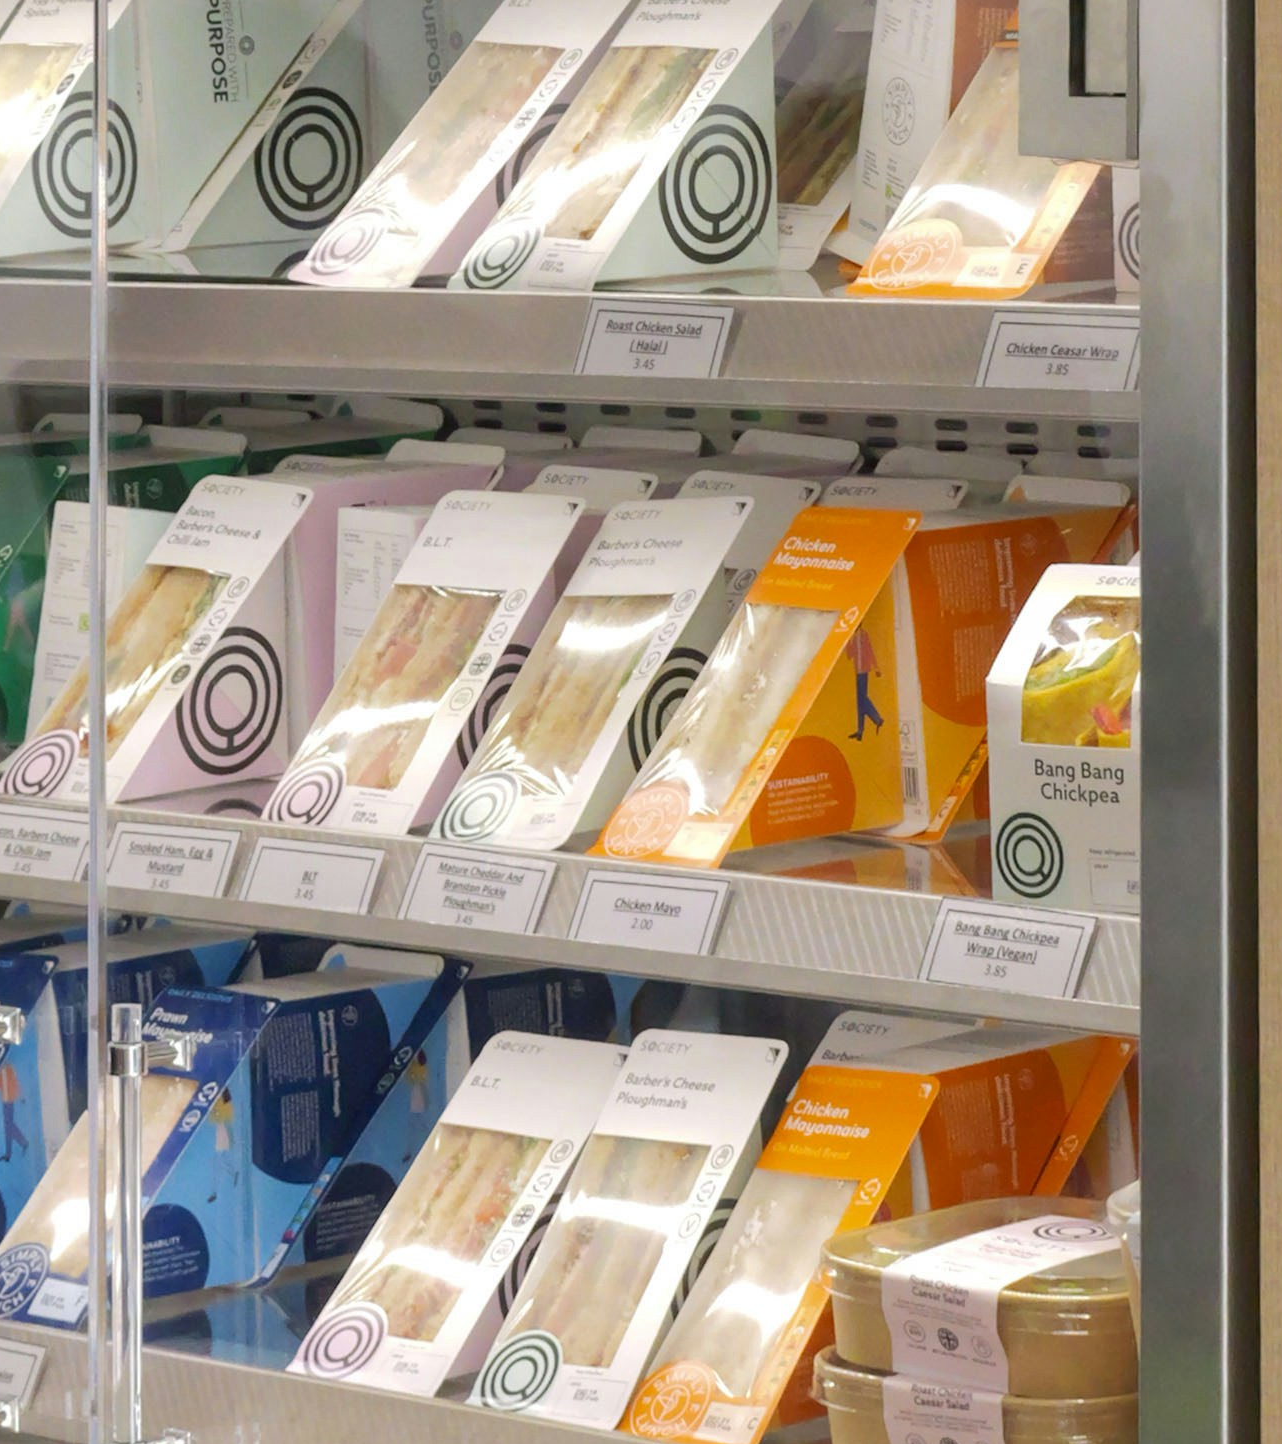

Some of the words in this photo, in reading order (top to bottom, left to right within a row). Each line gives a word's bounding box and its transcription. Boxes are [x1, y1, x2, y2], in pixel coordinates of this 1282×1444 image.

[605, 319, 634, 335] Roast
[635, 320, 674, 337] Chicken
[674, 323, 703, 338] Salad
[1006, 342, 1048, 358] Chicken
[1050, 344, 1088, 359] Ceasar
[1089, 345, 1120, 362] Wrap
[632, 357, 656, 371] 3.45
[1045, 361, 1070, 377] 3.85
[643, 536, 684, 551] Cheese
[783, 535, 837, 555] Chicken
[772, 552, 855, 573] Mayonnaise
[1034, 758, 1076, 783] Bang
[1080, 761, 1125, 785] Bang
[1040, 782, 1121, 805] Chickpea
[50, 833, 81, 847] Cheese
[129, 841, 164, 857] Smoked
[187, 846, 205, 862] Egg
[205, 848, 214, 861] &
[147, 861, 185, 876] Mustard
[301, 871, 319, 886] BLT
[437, 862, 469, 878] Mature
[469, 866, 505, 882] Cheddar
[505, 869, 526, 885] And
[150, 878, 171, 890] 3.45
[294, 887, 314, 901] 3.45
[442, 880, 483, 896] Branston
[482, 884, 507, 899] Pickle
[442, 895, 496, 915] Ploughman's
[613, 897, 653, 914] Chicken
[653, 901, 682, 918] Mayo
[630, 917, 654, 931] 2.00
[954, 919, 982, 939] Bang
[982, 923, 1011, 942] Bang
[1011, 926, 1061, 947] Chickpea
[965, 942, 995, 960] Wrap
[995, 945, 1038, 965] (Vegan)
[982, 963, 1008, 979] 3.85
[149, 1006, 189, 1025] Prawn
[624, 1072, 671, 1088] Barber's
[673, 1076, 717, 1093] Cheese
[616, 1091, 687, 1110] Ploughman's
[792, 1099, 850, 1120] Chicken
[783, 1115, 871, 1139] Mayonnaise
[0, 1246, 47, 1280] SIMPLY
[652, 1366, 707, 1398] SIMPLY
